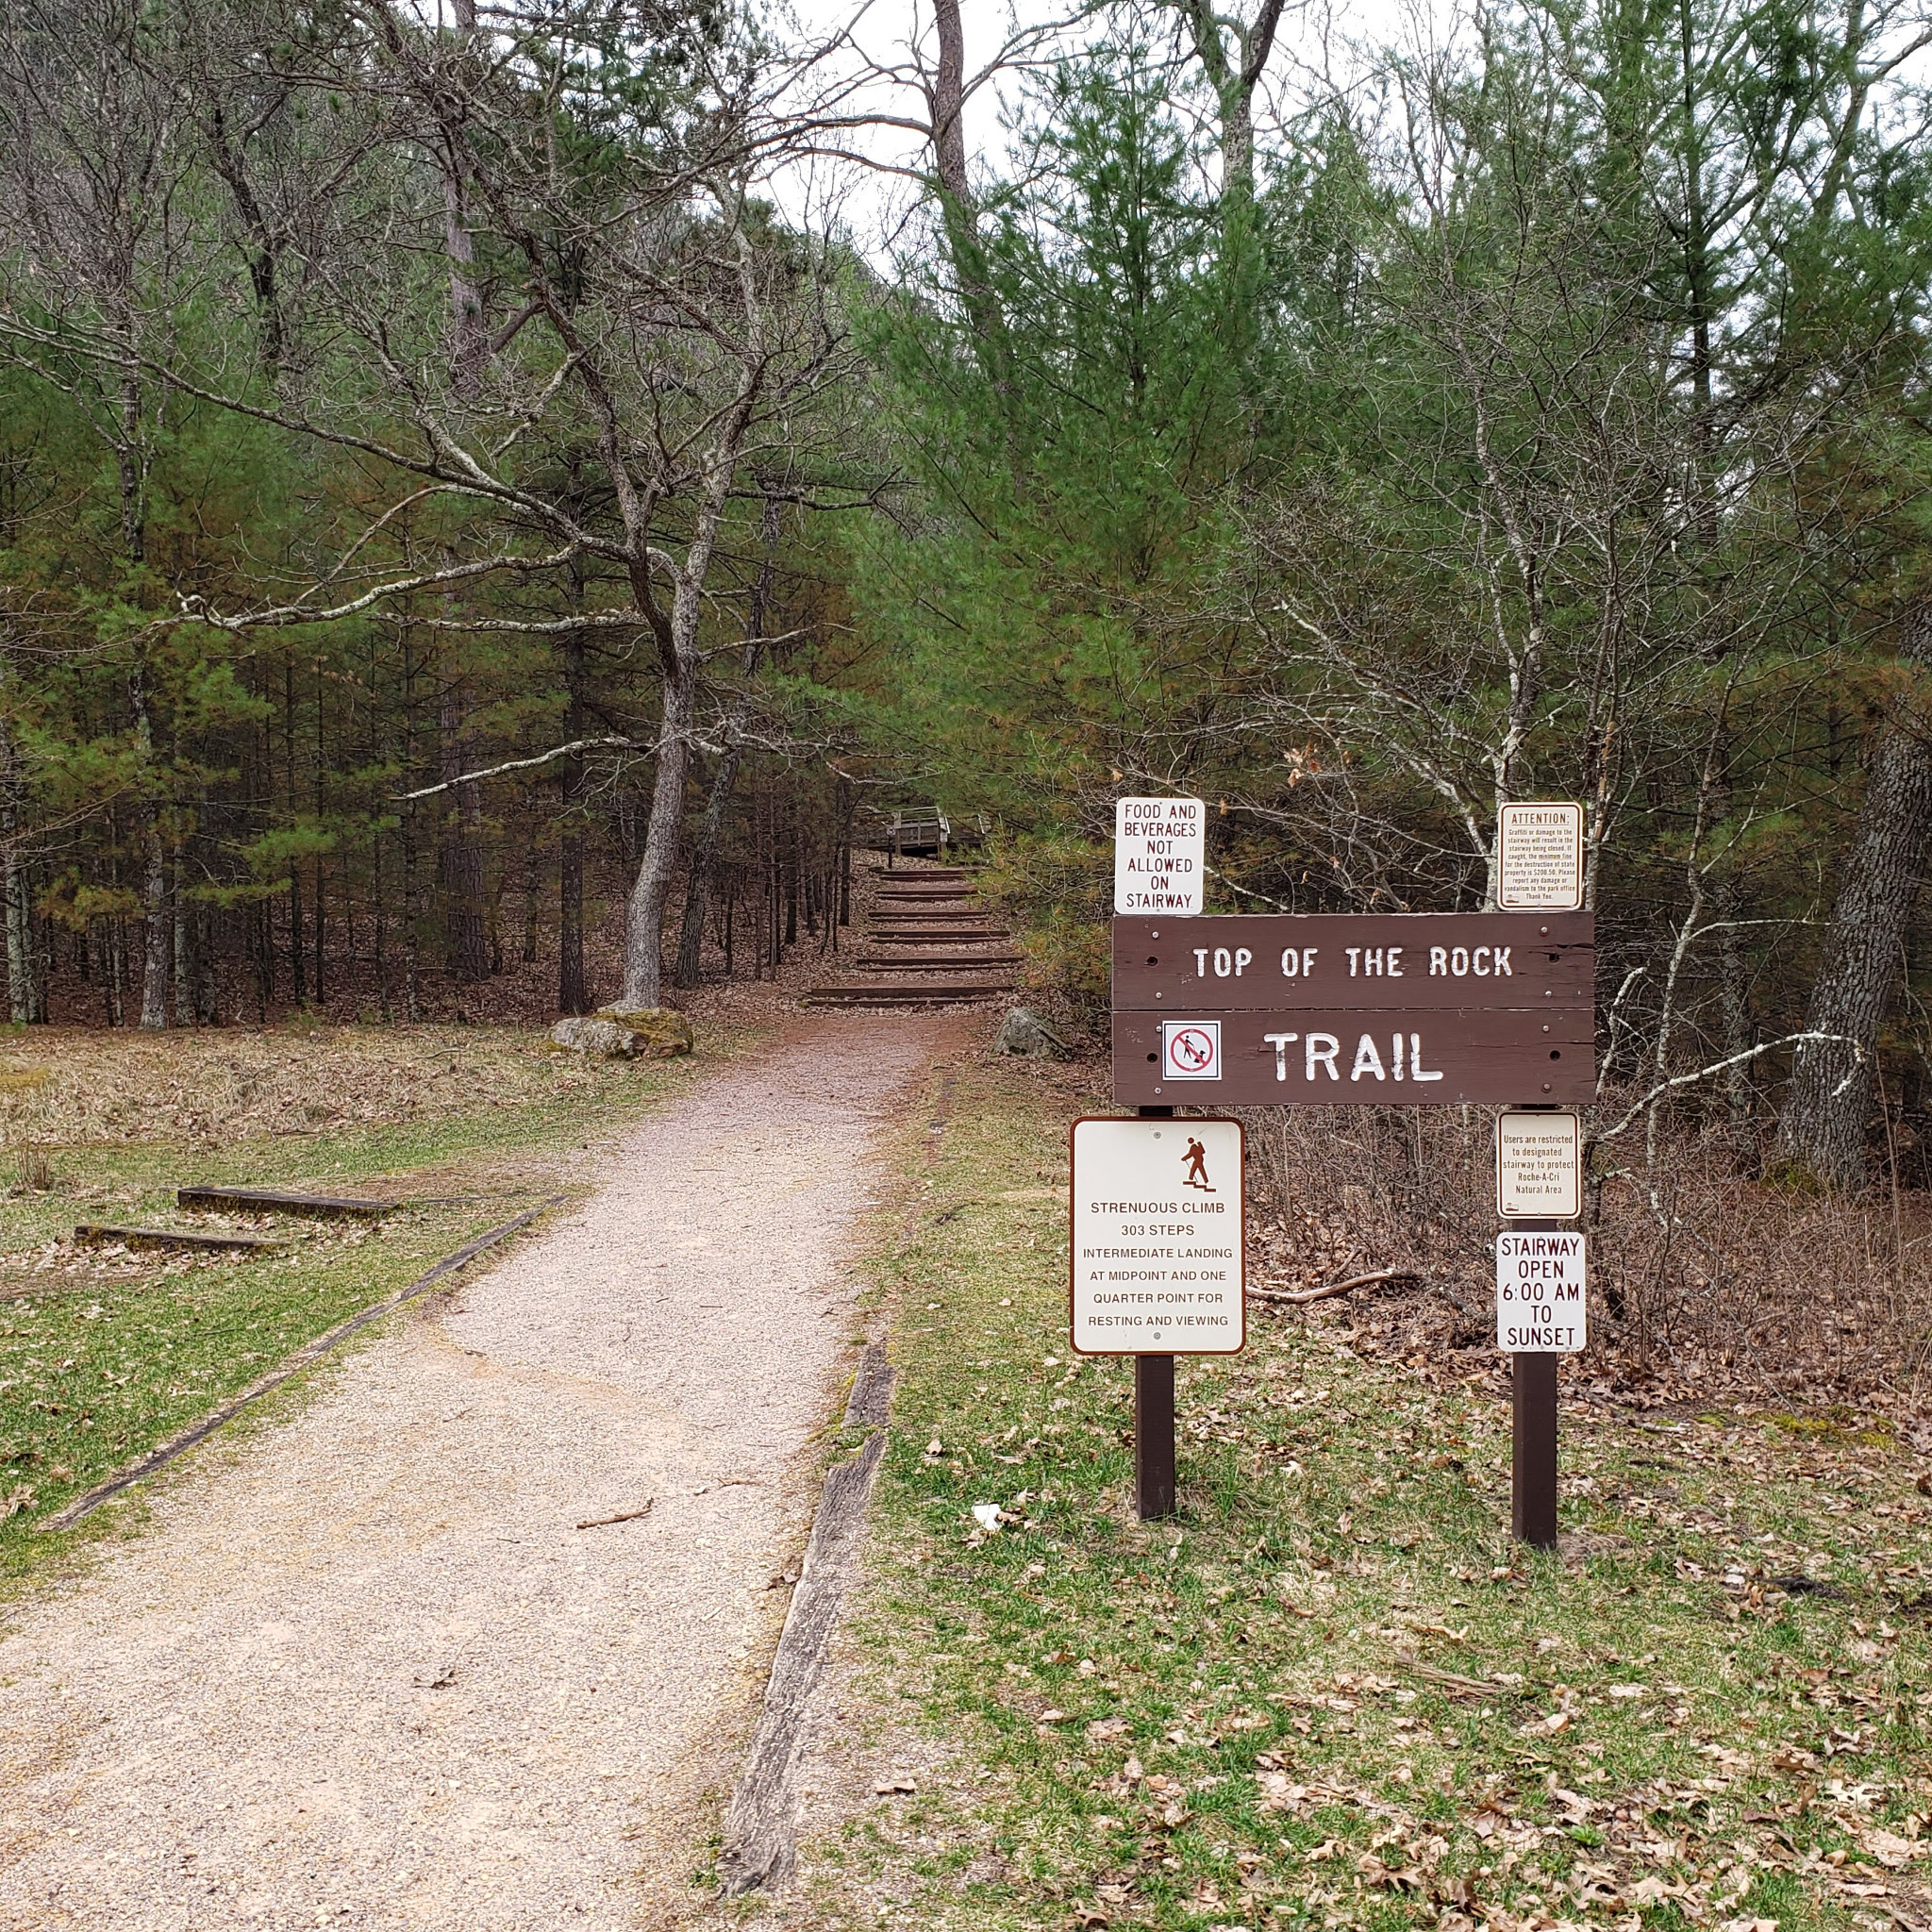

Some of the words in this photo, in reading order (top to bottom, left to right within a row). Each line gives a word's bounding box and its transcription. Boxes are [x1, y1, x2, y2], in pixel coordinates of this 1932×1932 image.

[1124, 804, 1161, 819] FOOD
[1169, 804, 1197, 819] AND
[1512, 813, 1569, 824] ATTENTION:
[1124, 822, 1196, 837] BEVERAGES
[1147, 840, 1173, 855] NOT
[1127, 858, 1193, 873] ALLOWED
[1150, 876, 1169, 891] ON
[1126, 893, 1193, 908] STAIRWAY
[1193, 948, 1253, 978] TOP
[1282, 947, 1318, 978] OF
[1346, 947, 1403, 977] THE
[1429, 946, 1513, 977] ROCK
[1264, 1032, 1444, 1082] TRAIL
[1504, 1135, 1523, 1144] Users
[1538, 1135, 1572, 1144] restricted
[1512, 1148, 1520, 1156] to
[1522, 1148, 1562, 1158] designated
[1503, 1161, 1535, 1171] stairway
[1547, 1161, 1574, 1171] protect
[1518, 1173, 1559, 1182] Roche-A-Cri
[1516, 1185, 1543, 1194] Natural
[1545, 1185, 1562, 1194] Area
[1091, 1202, 1178, 1214] STRENUOUS
[1182, 1202, 1225, 1214] CLIMB
[1121, 1225, 1145, 1236] 303
[1149, 1225, 1194, 1236] STEPS
[1084, 1248, 1174, 1259] INTERMEDIATE
[1178, 1248, 1233, 1259] LANDING
[1501, 1238, 1579, 1256] STAIRWAY
[1090, 1271, 1105, 1281] AT
[1109, 1271, 1167, 1281] MIDPOINT
[1171, 1271, 1197, 1281] AND
[1200, 1271, 1226, 1281] ONE
[1518, 1261, 1564, 1279] OPEN
[1094, 1293, 1153, 1304] QUARTER
[1157, 1293, 1194, 1304] POINT
[1198, 1293, 1223, 1304] FOR
[1503, 1283, 1543, 1301] 6:00
[1555, 1283, 1579, 1301] AM
[1088, 1316, 1142, 1326] RESTING
[1146, 1316, 1172, 1326] AND
[1176, 1316, 1228, 1326] VIEWING
[1531, 1305, 1551, 1323] TO
[1507, 1328, 1575, 1346] SUNSET
